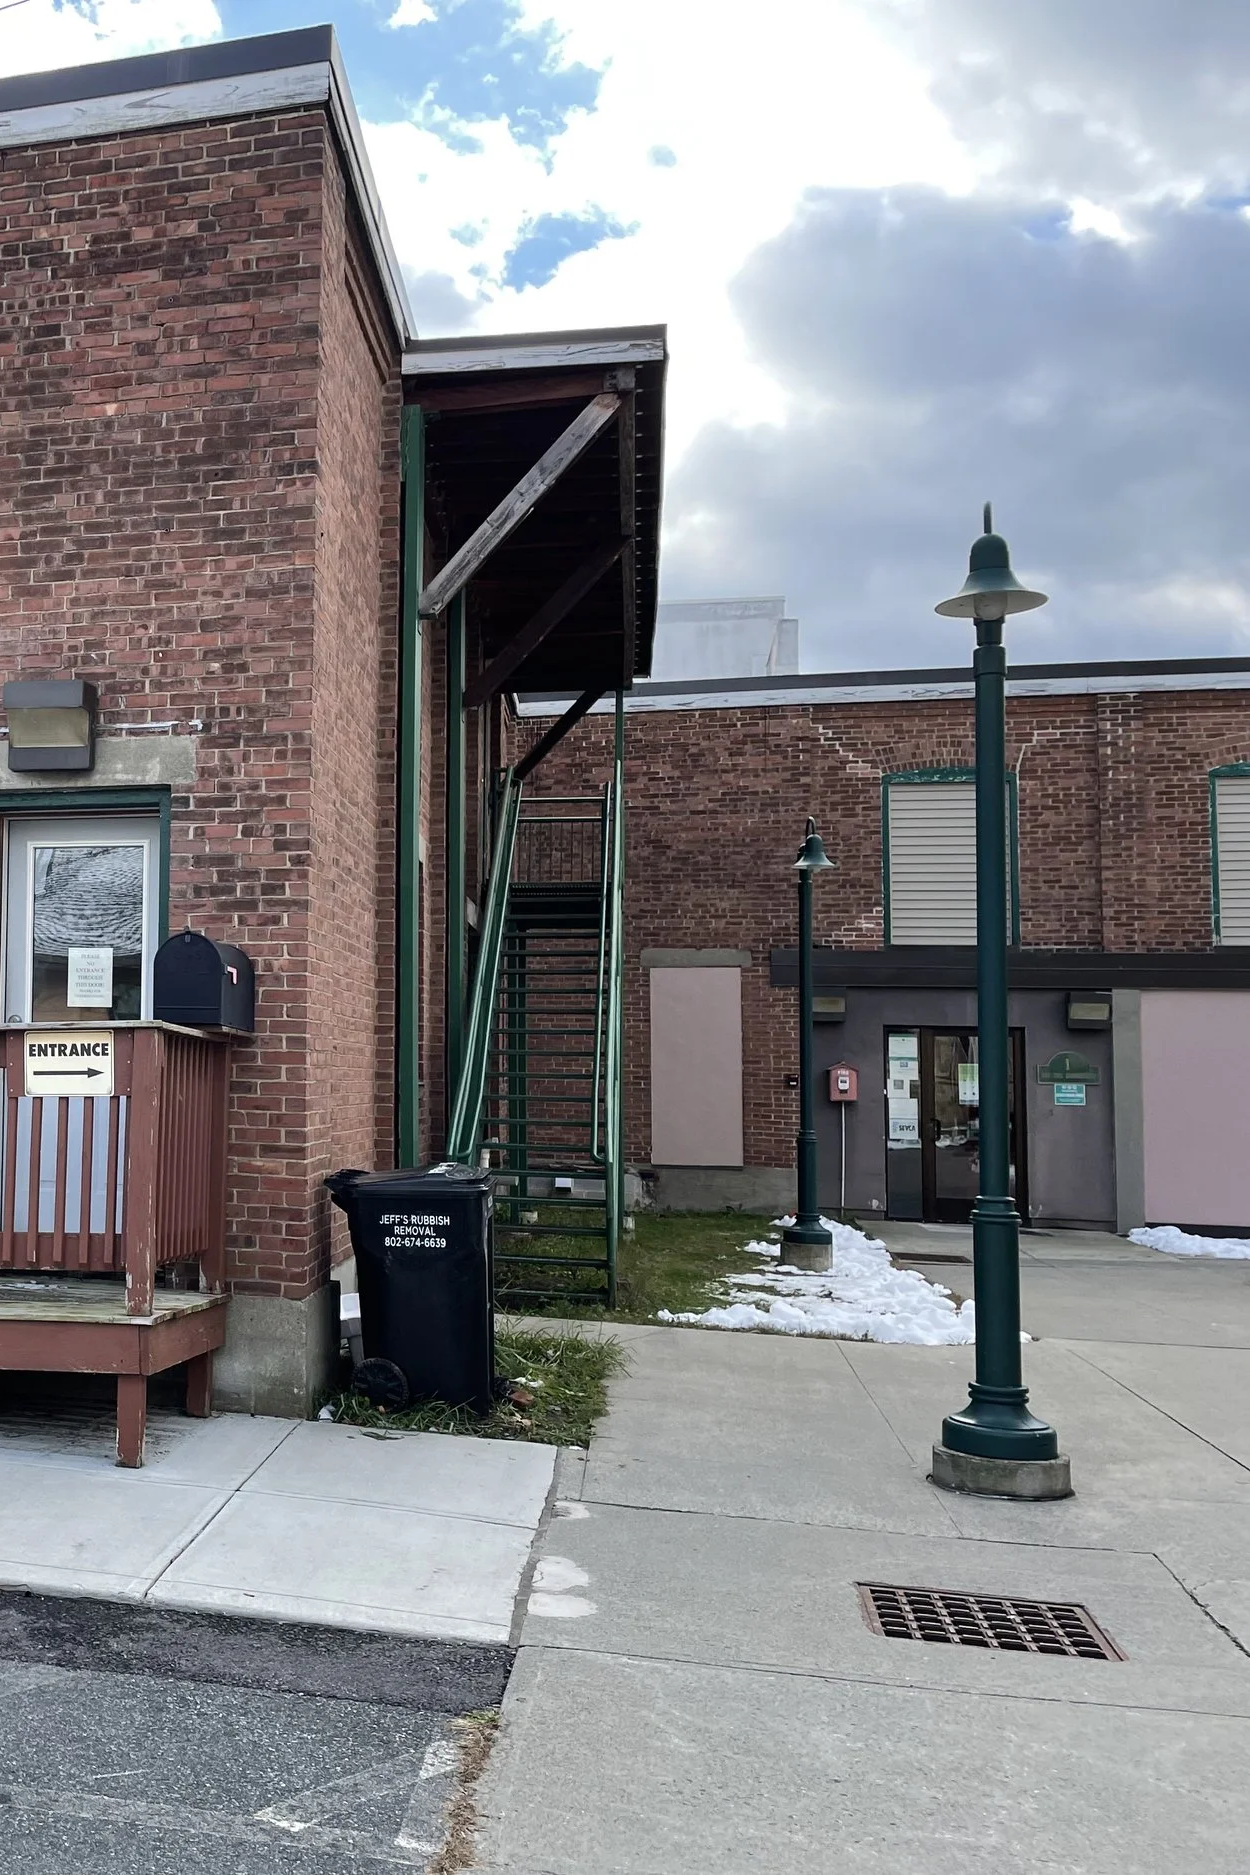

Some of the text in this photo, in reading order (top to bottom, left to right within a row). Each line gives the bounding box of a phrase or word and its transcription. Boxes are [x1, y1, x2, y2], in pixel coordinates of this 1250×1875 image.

[28, 1042, 110, 1058] ENTRANCE
[379, 1215, 450, 1226] JEFF'S RUBBISH
[394, 1226, 436, 1236] REMOVAL
[384, 1237, 447, 1248] 802-674-6639
